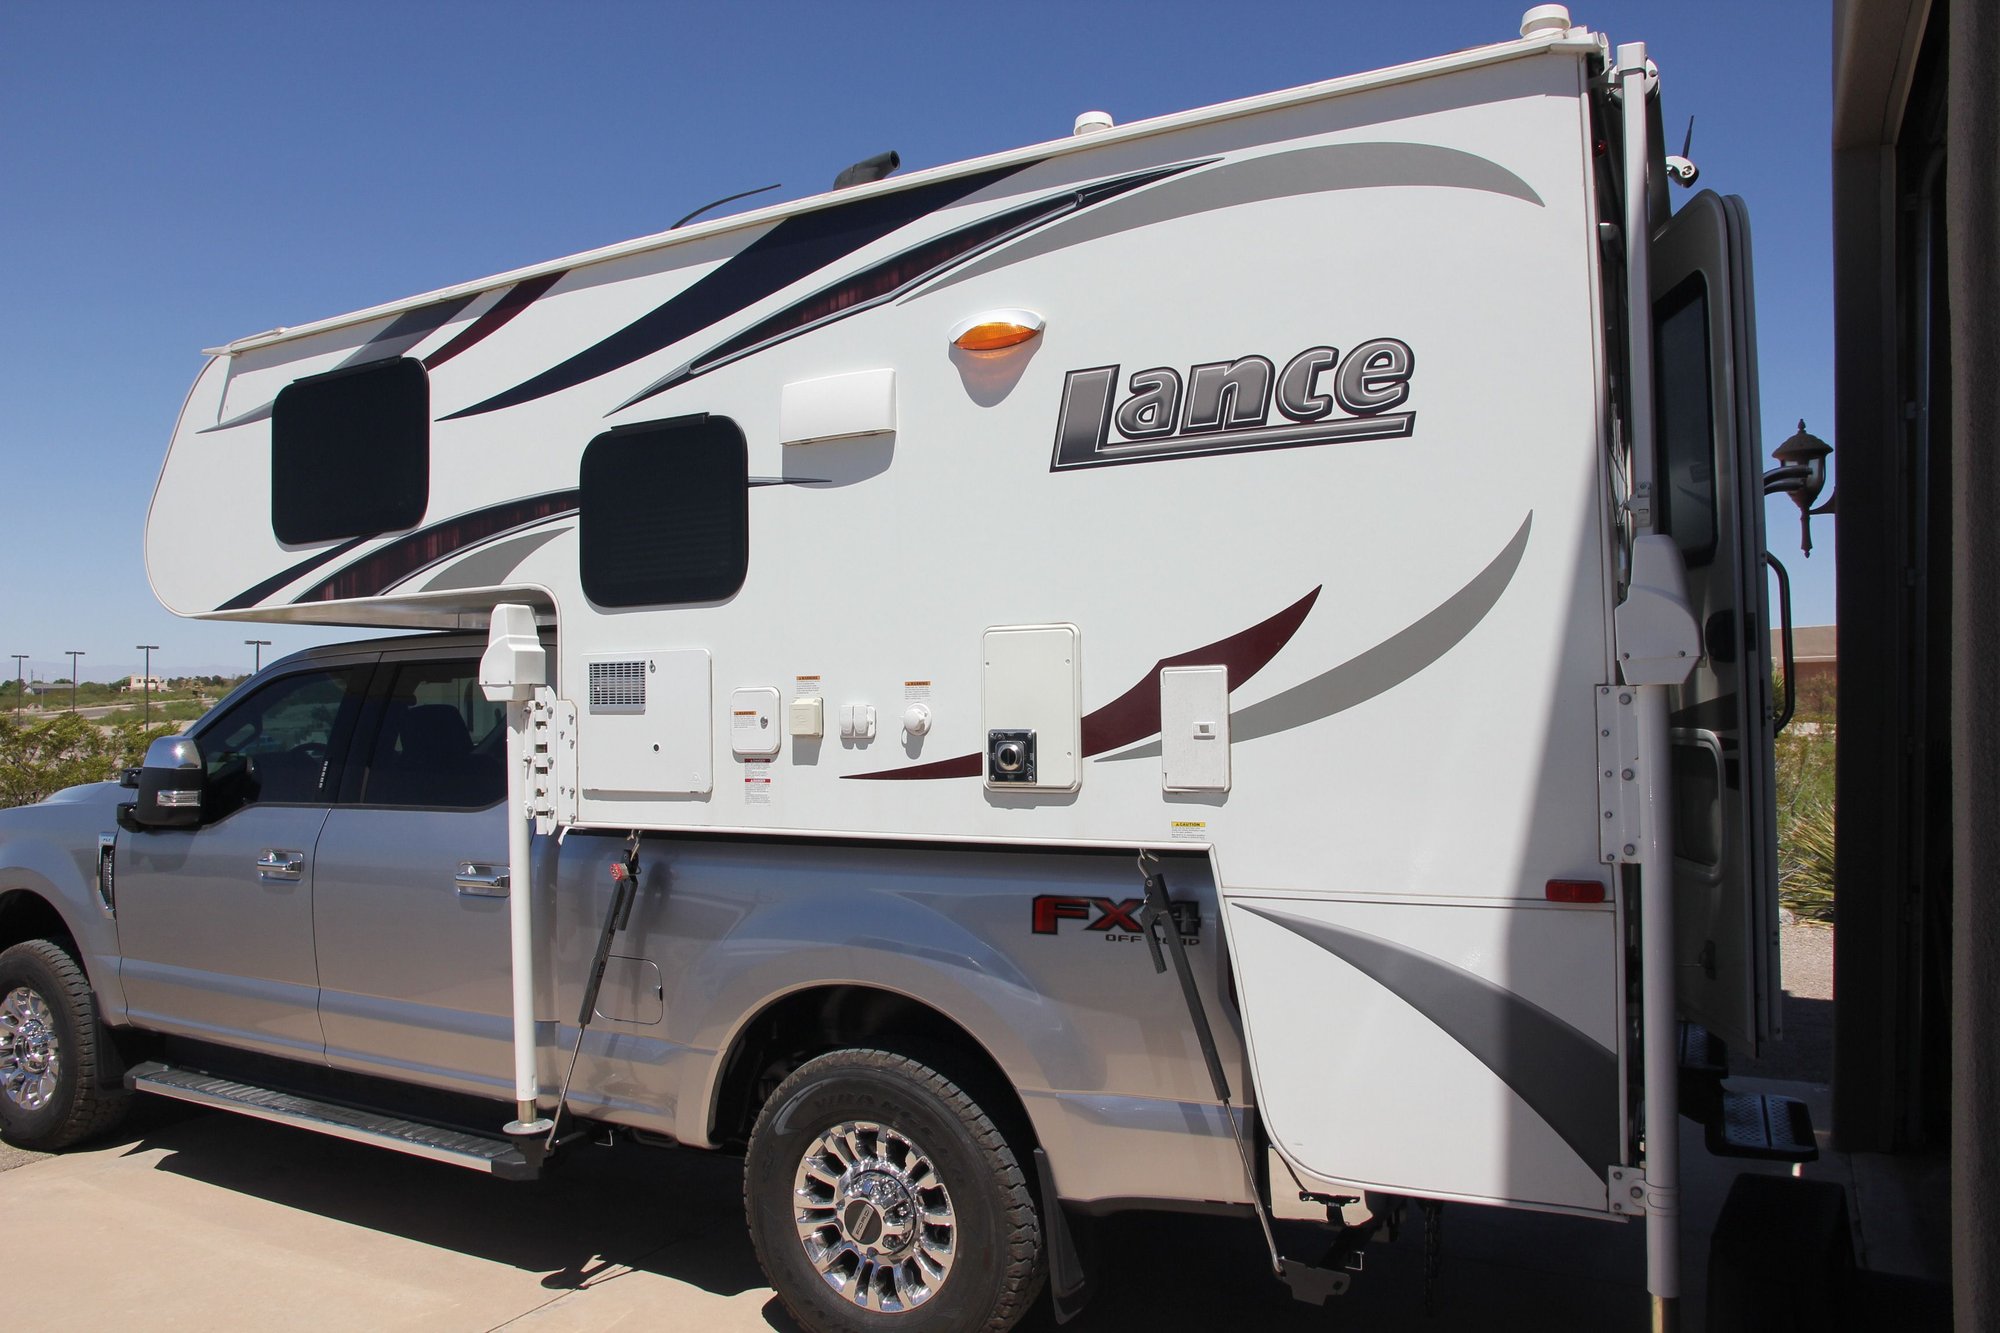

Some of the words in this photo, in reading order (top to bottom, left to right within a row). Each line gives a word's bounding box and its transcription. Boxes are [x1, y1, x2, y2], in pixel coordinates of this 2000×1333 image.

[1049, 337, 1417, 473] Lance
[1032, 894, 1201, 936] FX4
[1105, 934, 1142, 943] OFF
